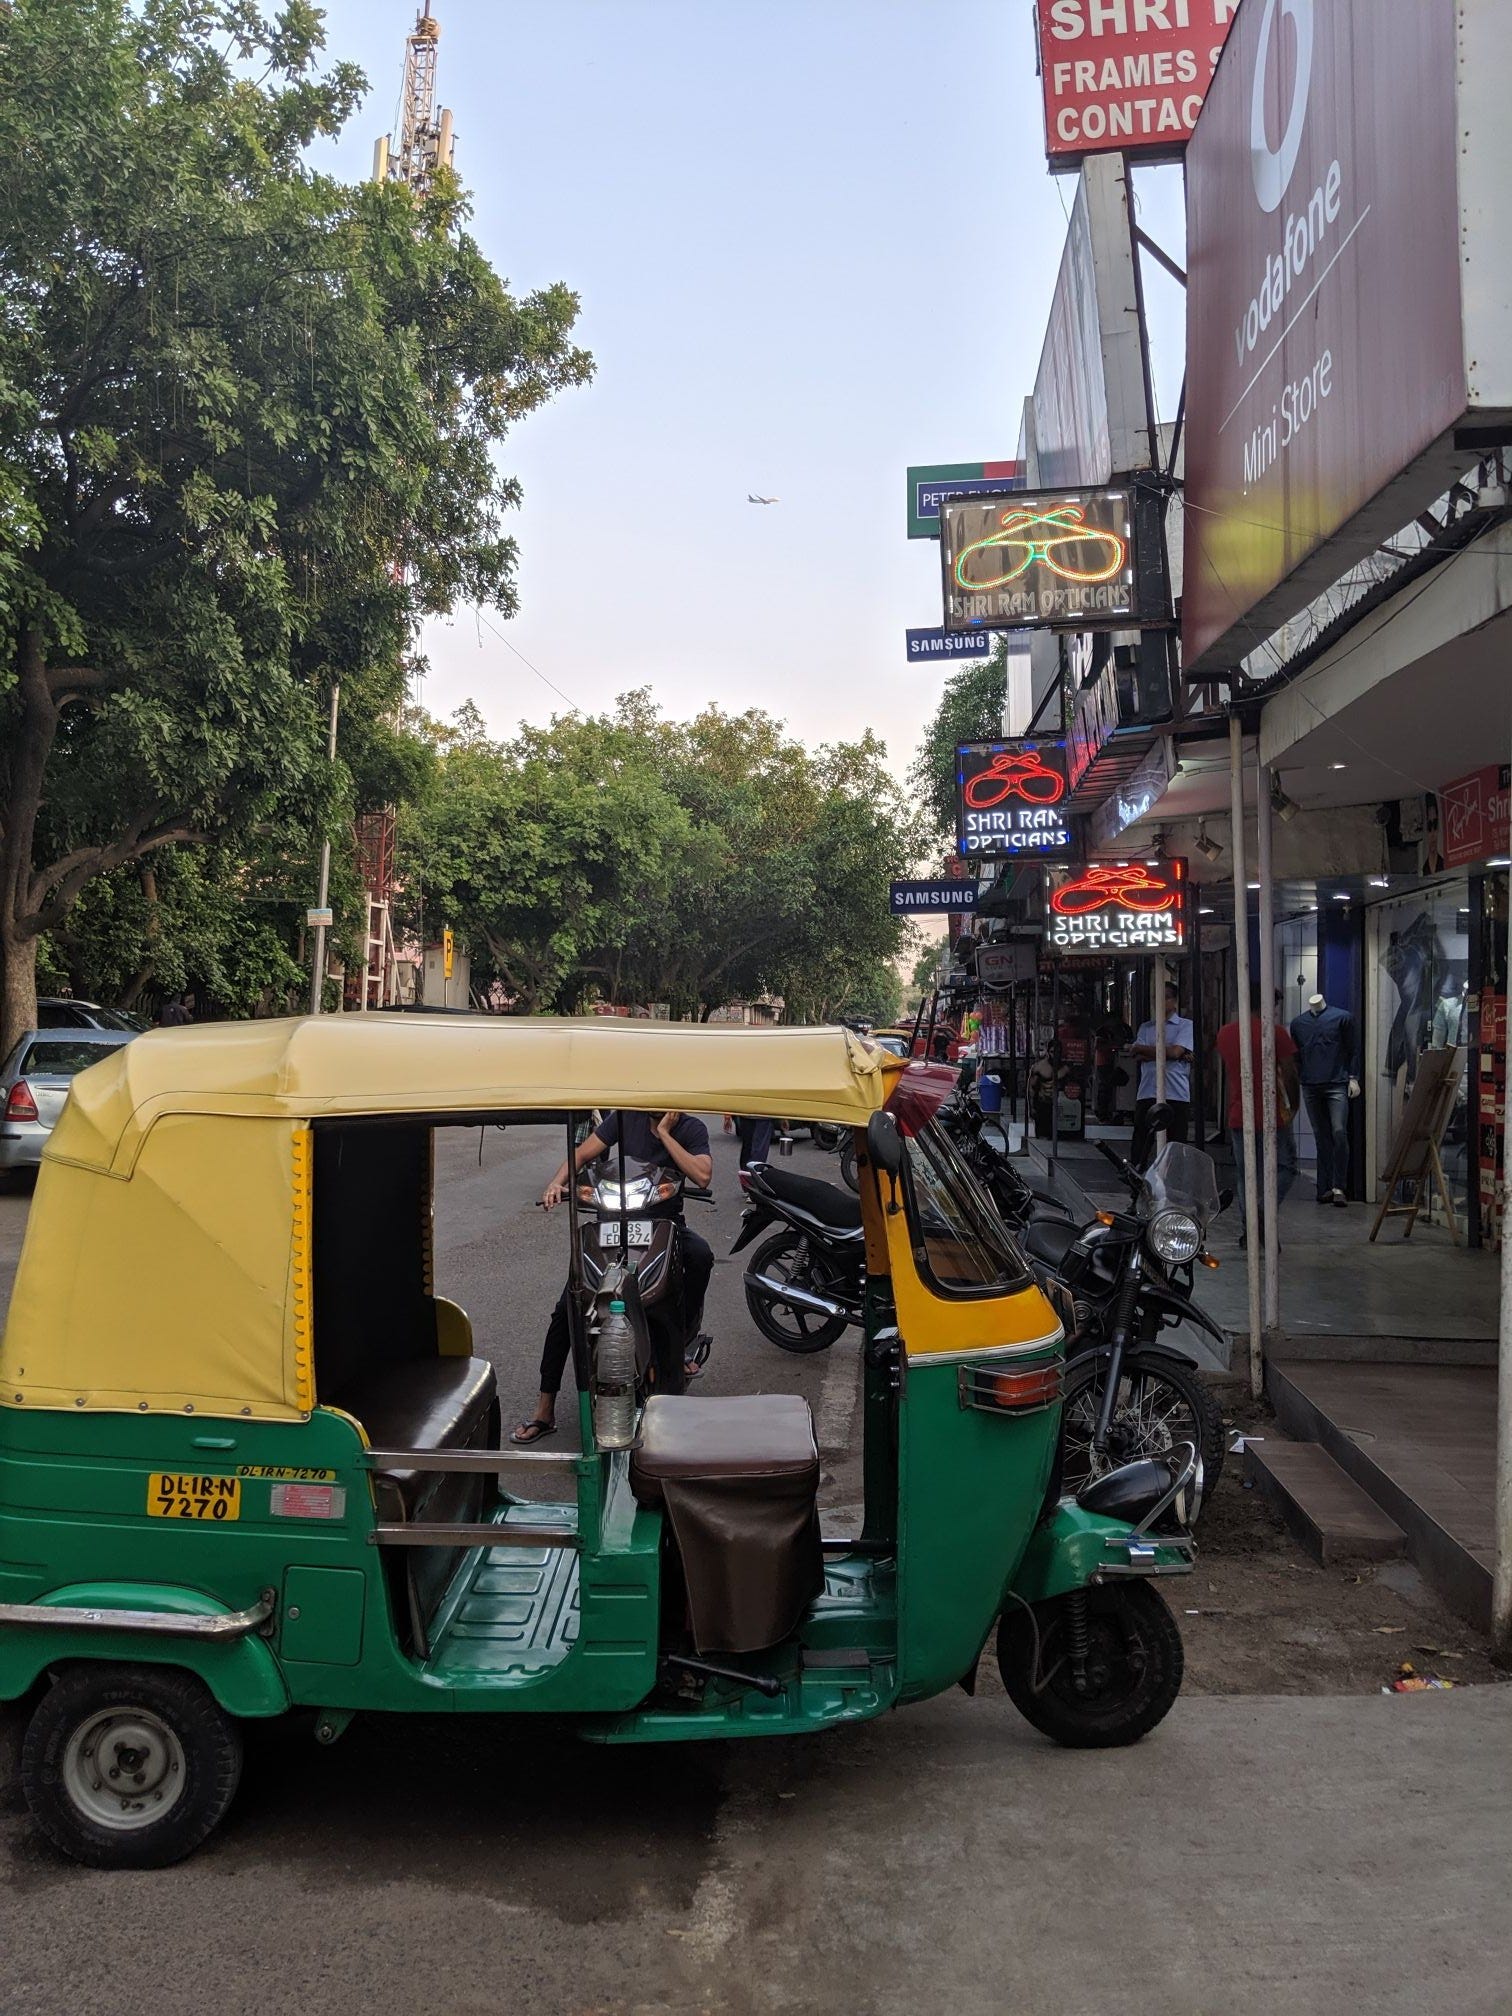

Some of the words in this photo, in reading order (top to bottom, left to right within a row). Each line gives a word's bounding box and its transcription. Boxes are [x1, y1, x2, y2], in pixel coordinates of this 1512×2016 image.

[1050, 0, 1189, 41] SHRI
[1053, 49, 1198, 95] FRAMES
[1234, 159, 1341, 368] vodafone
[1243, 406, 1277, 484] Mini
[1281, 349, 1332, 447] Store
[953, 595, 993, 618] SHRI
[999, 591, 1036, 616] RAM
[1041, 585, 1130, 613] OPTICIANS
[911, 636, 985, 653] SAMSUNG
[966, 812, 1012, 832] SHRI
[967, 831, 1068, 850] OPTICIANS
[894, 890, 974, 905] SAMSUNG
[1055, 915, 1109, 932] SHRI
[1118, 912, 1173, 928] RAM
[1053, 929, 1178, 945] OPTICIANS
[157, 1497, 228, 1519] 7270
